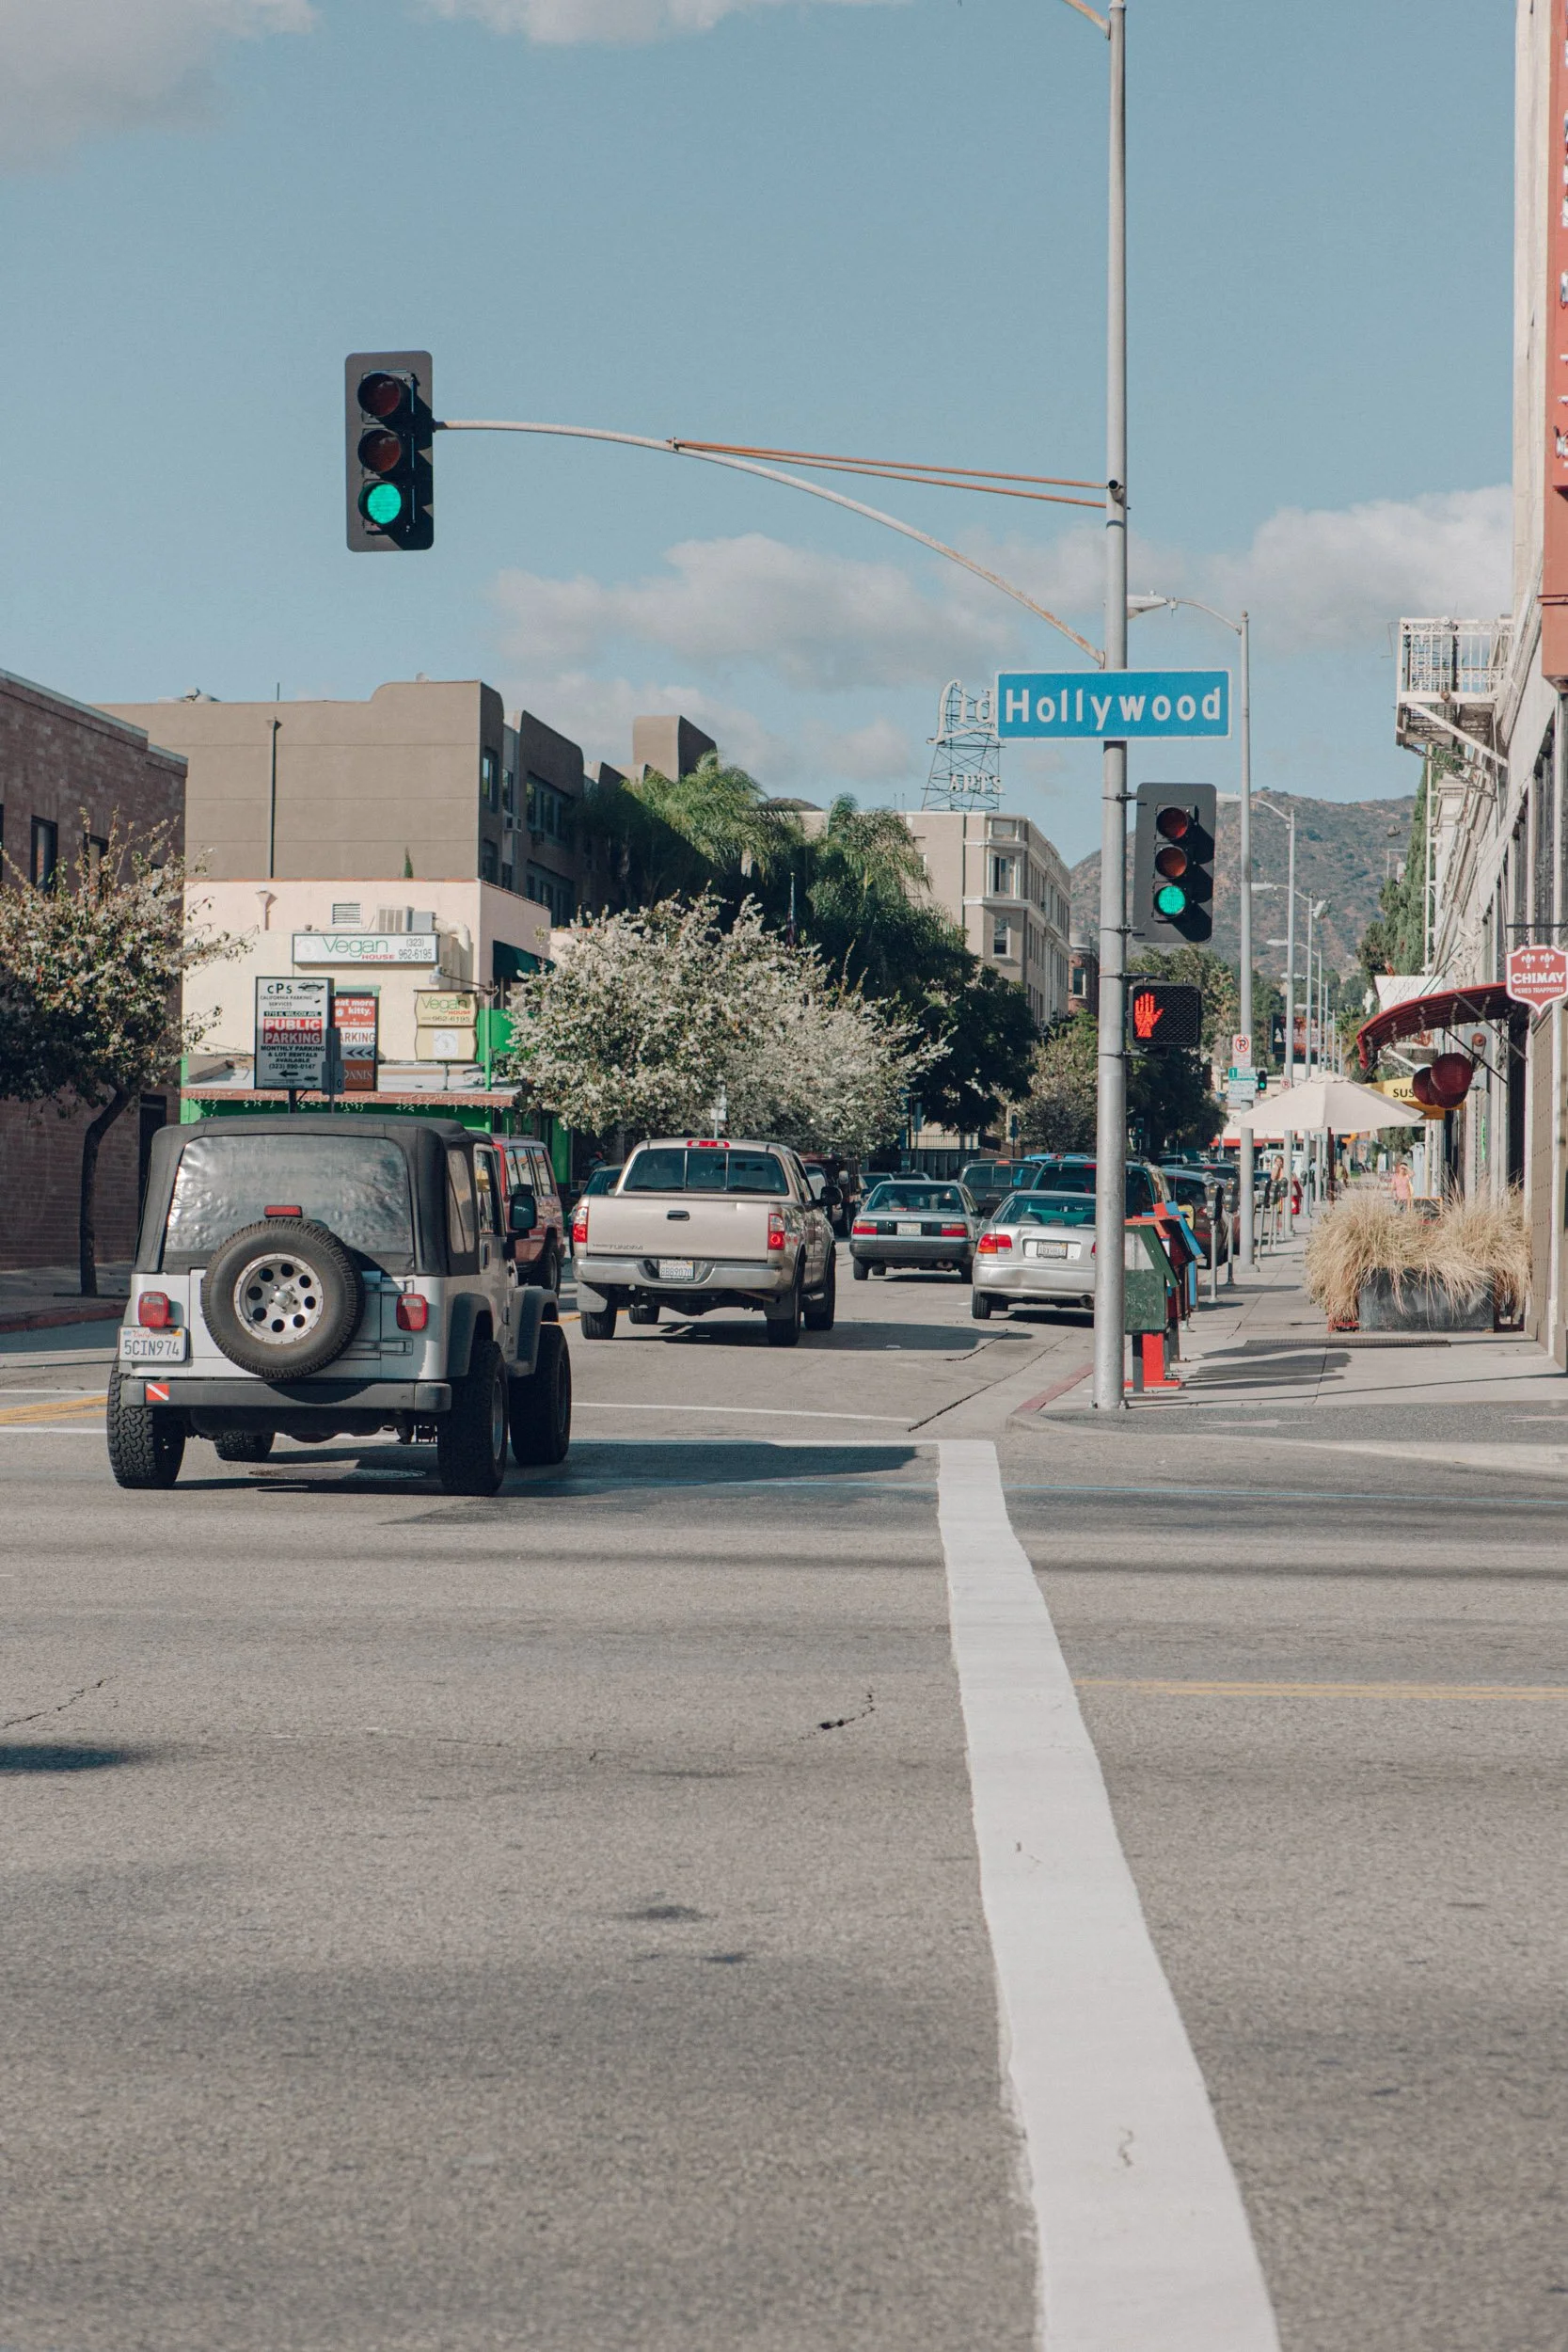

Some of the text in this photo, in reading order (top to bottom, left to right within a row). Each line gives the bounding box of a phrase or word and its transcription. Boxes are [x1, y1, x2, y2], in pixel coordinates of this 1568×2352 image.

[1006, 687, 1221, 731] Hollywood
[323, 935, 388, 958] Vegan
[398, 948, 433, 960] 962-6195
[1512, 972, 1565, 984] CHIMAY
[420, 995, 468, 1013] Vegan
[264, 1019, 321, 1031] PUBLIC
[264, 1032, 321, 1043] PARKING
[340, 1032, 376, 1042] ARKING
[1392, 1089, 1415, 1098] SUS
[124, 1340, 180, 1356] 5CIN974
